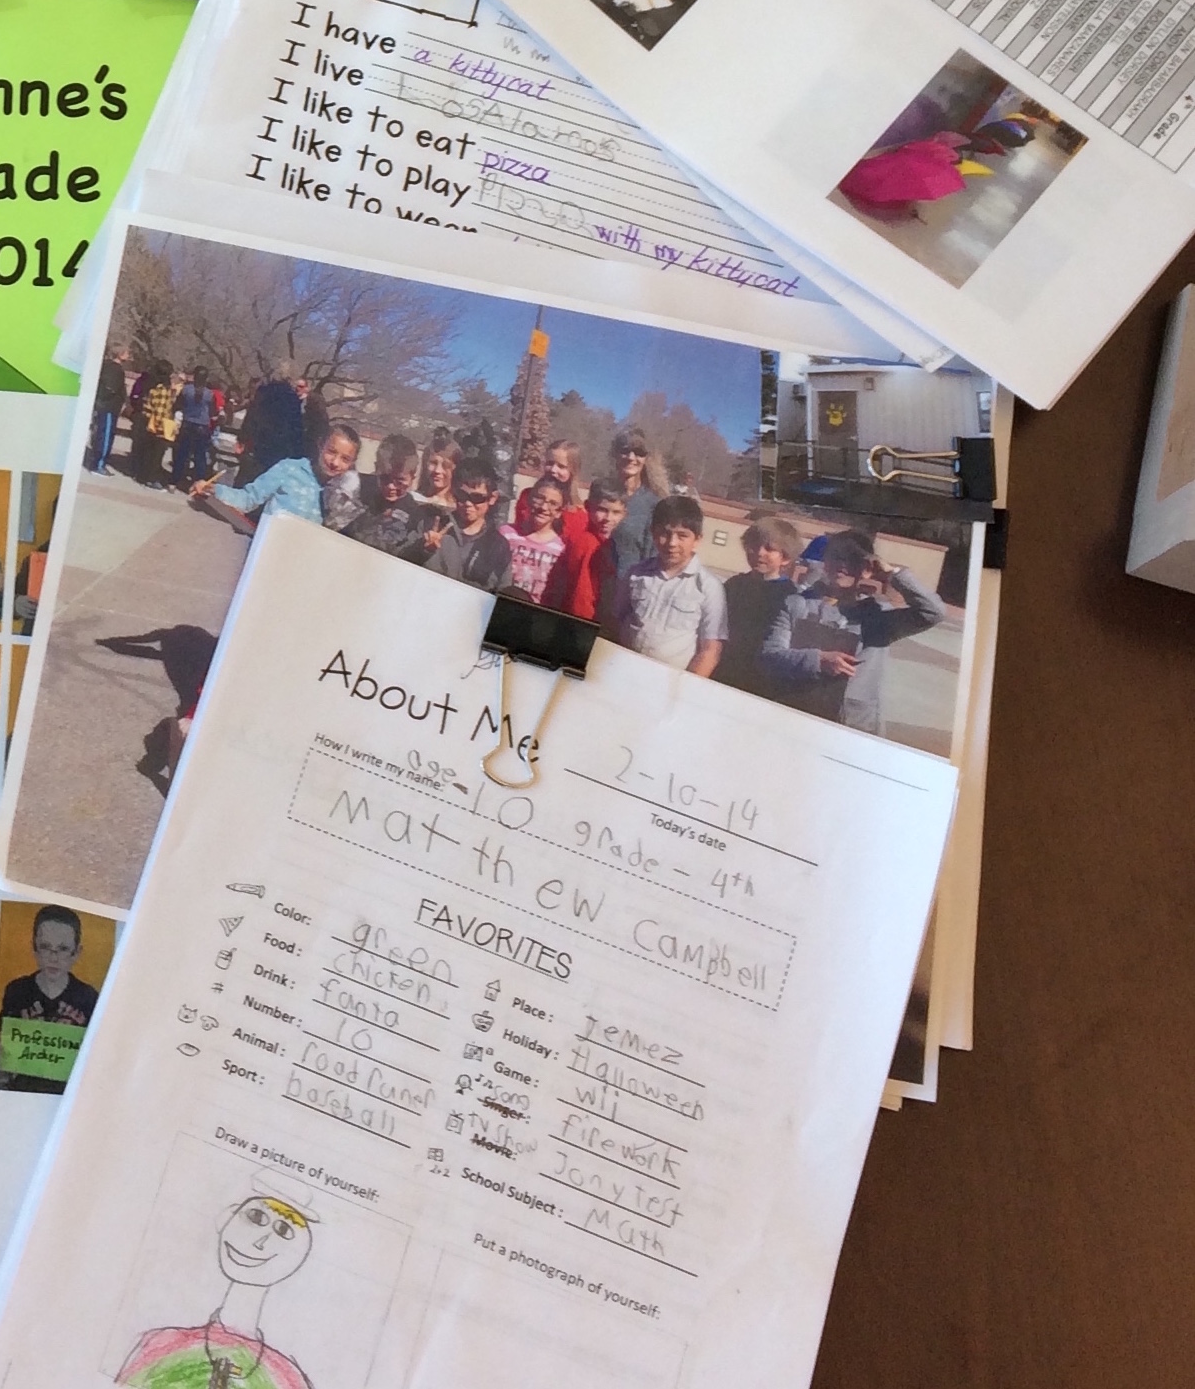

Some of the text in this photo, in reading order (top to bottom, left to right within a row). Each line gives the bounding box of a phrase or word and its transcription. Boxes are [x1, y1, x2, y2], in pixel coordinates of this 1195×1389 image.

[291, 1, 397, 54] I have
[413, 48, 434, 64] a
[268, 77, 477, 161] I like to eat
[257, 115, 471, 210] I like to play
[481, 151, 551, 185] pizza
[593, 222, 642, 253] with
[654, 243, 684, 272] my
[318, 648, 458, 735] About
[613, 745, 760, 832] 2-10-14
[649, 812, 728, 852] Today's date
[416, 898, 572, 979] FAVORITES
[215, 1126, 249, 1151] Draw
[261, 1147, 305, 1173] picture
[308, 1165, 323, 1179] of
[323, 1171, 380, 1204] yourself:
[461, 1167, 506, 1196] School
